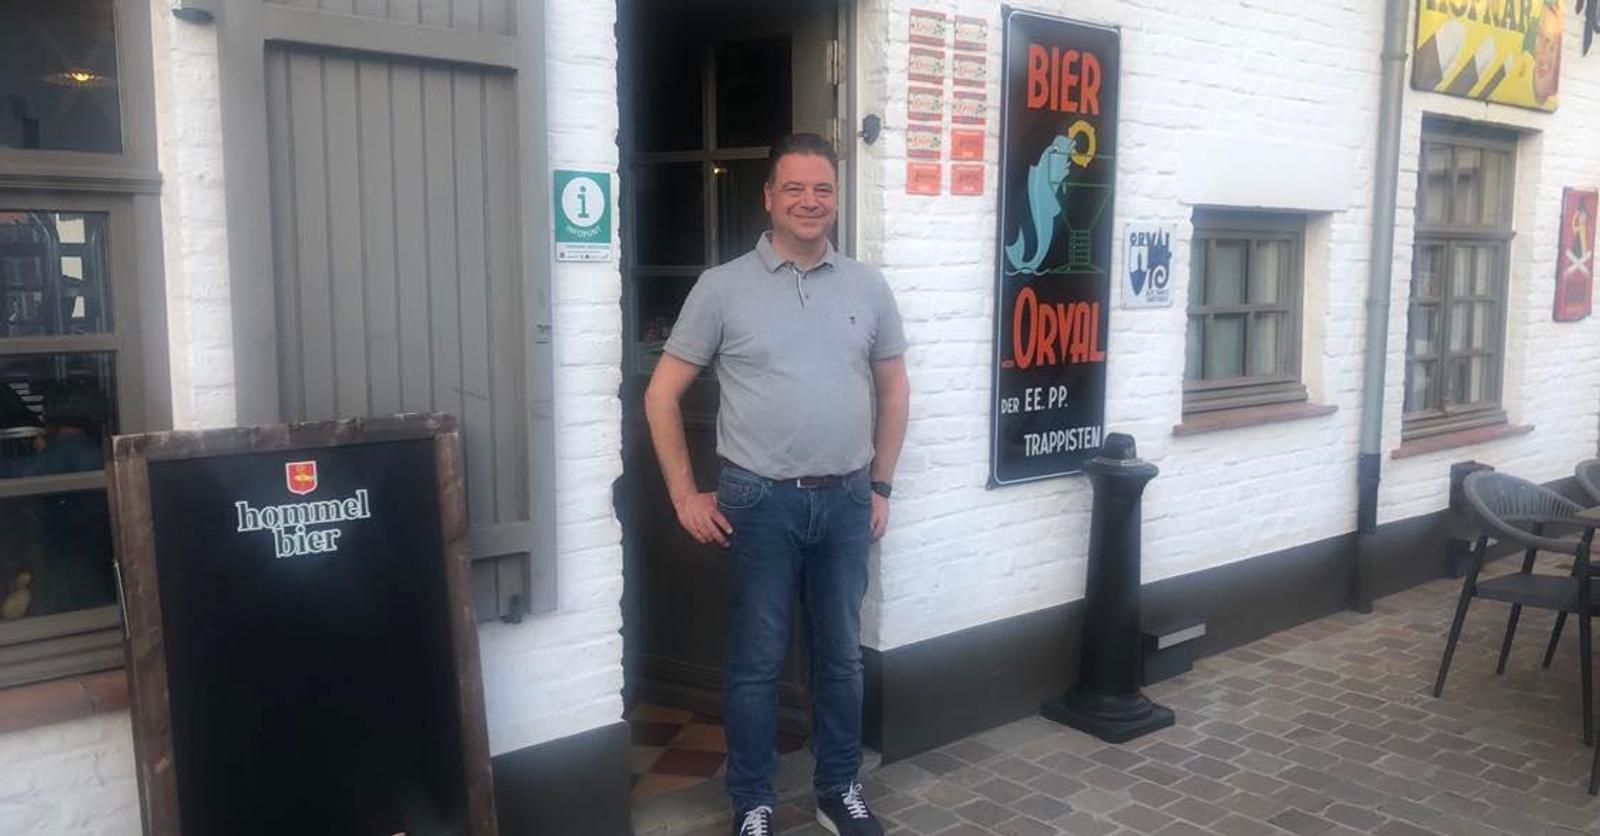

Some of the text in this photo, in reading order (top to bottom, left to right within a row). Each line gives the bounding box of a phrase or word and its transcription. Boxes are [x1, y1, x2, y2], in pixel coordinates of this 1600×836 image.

[1426, 0, 1532, 33] ONAR
[1026, 43, 1102, 116] BIER
[1013, 285, 1106, 370] ORVAL
[1001, 385, 1069, 414] DER EE. PP.
[1023, 425, 1101, 457] TRAPPISTEN
[235, 489, 371, 532] hommel
[272, 525, 341, 558] bier
